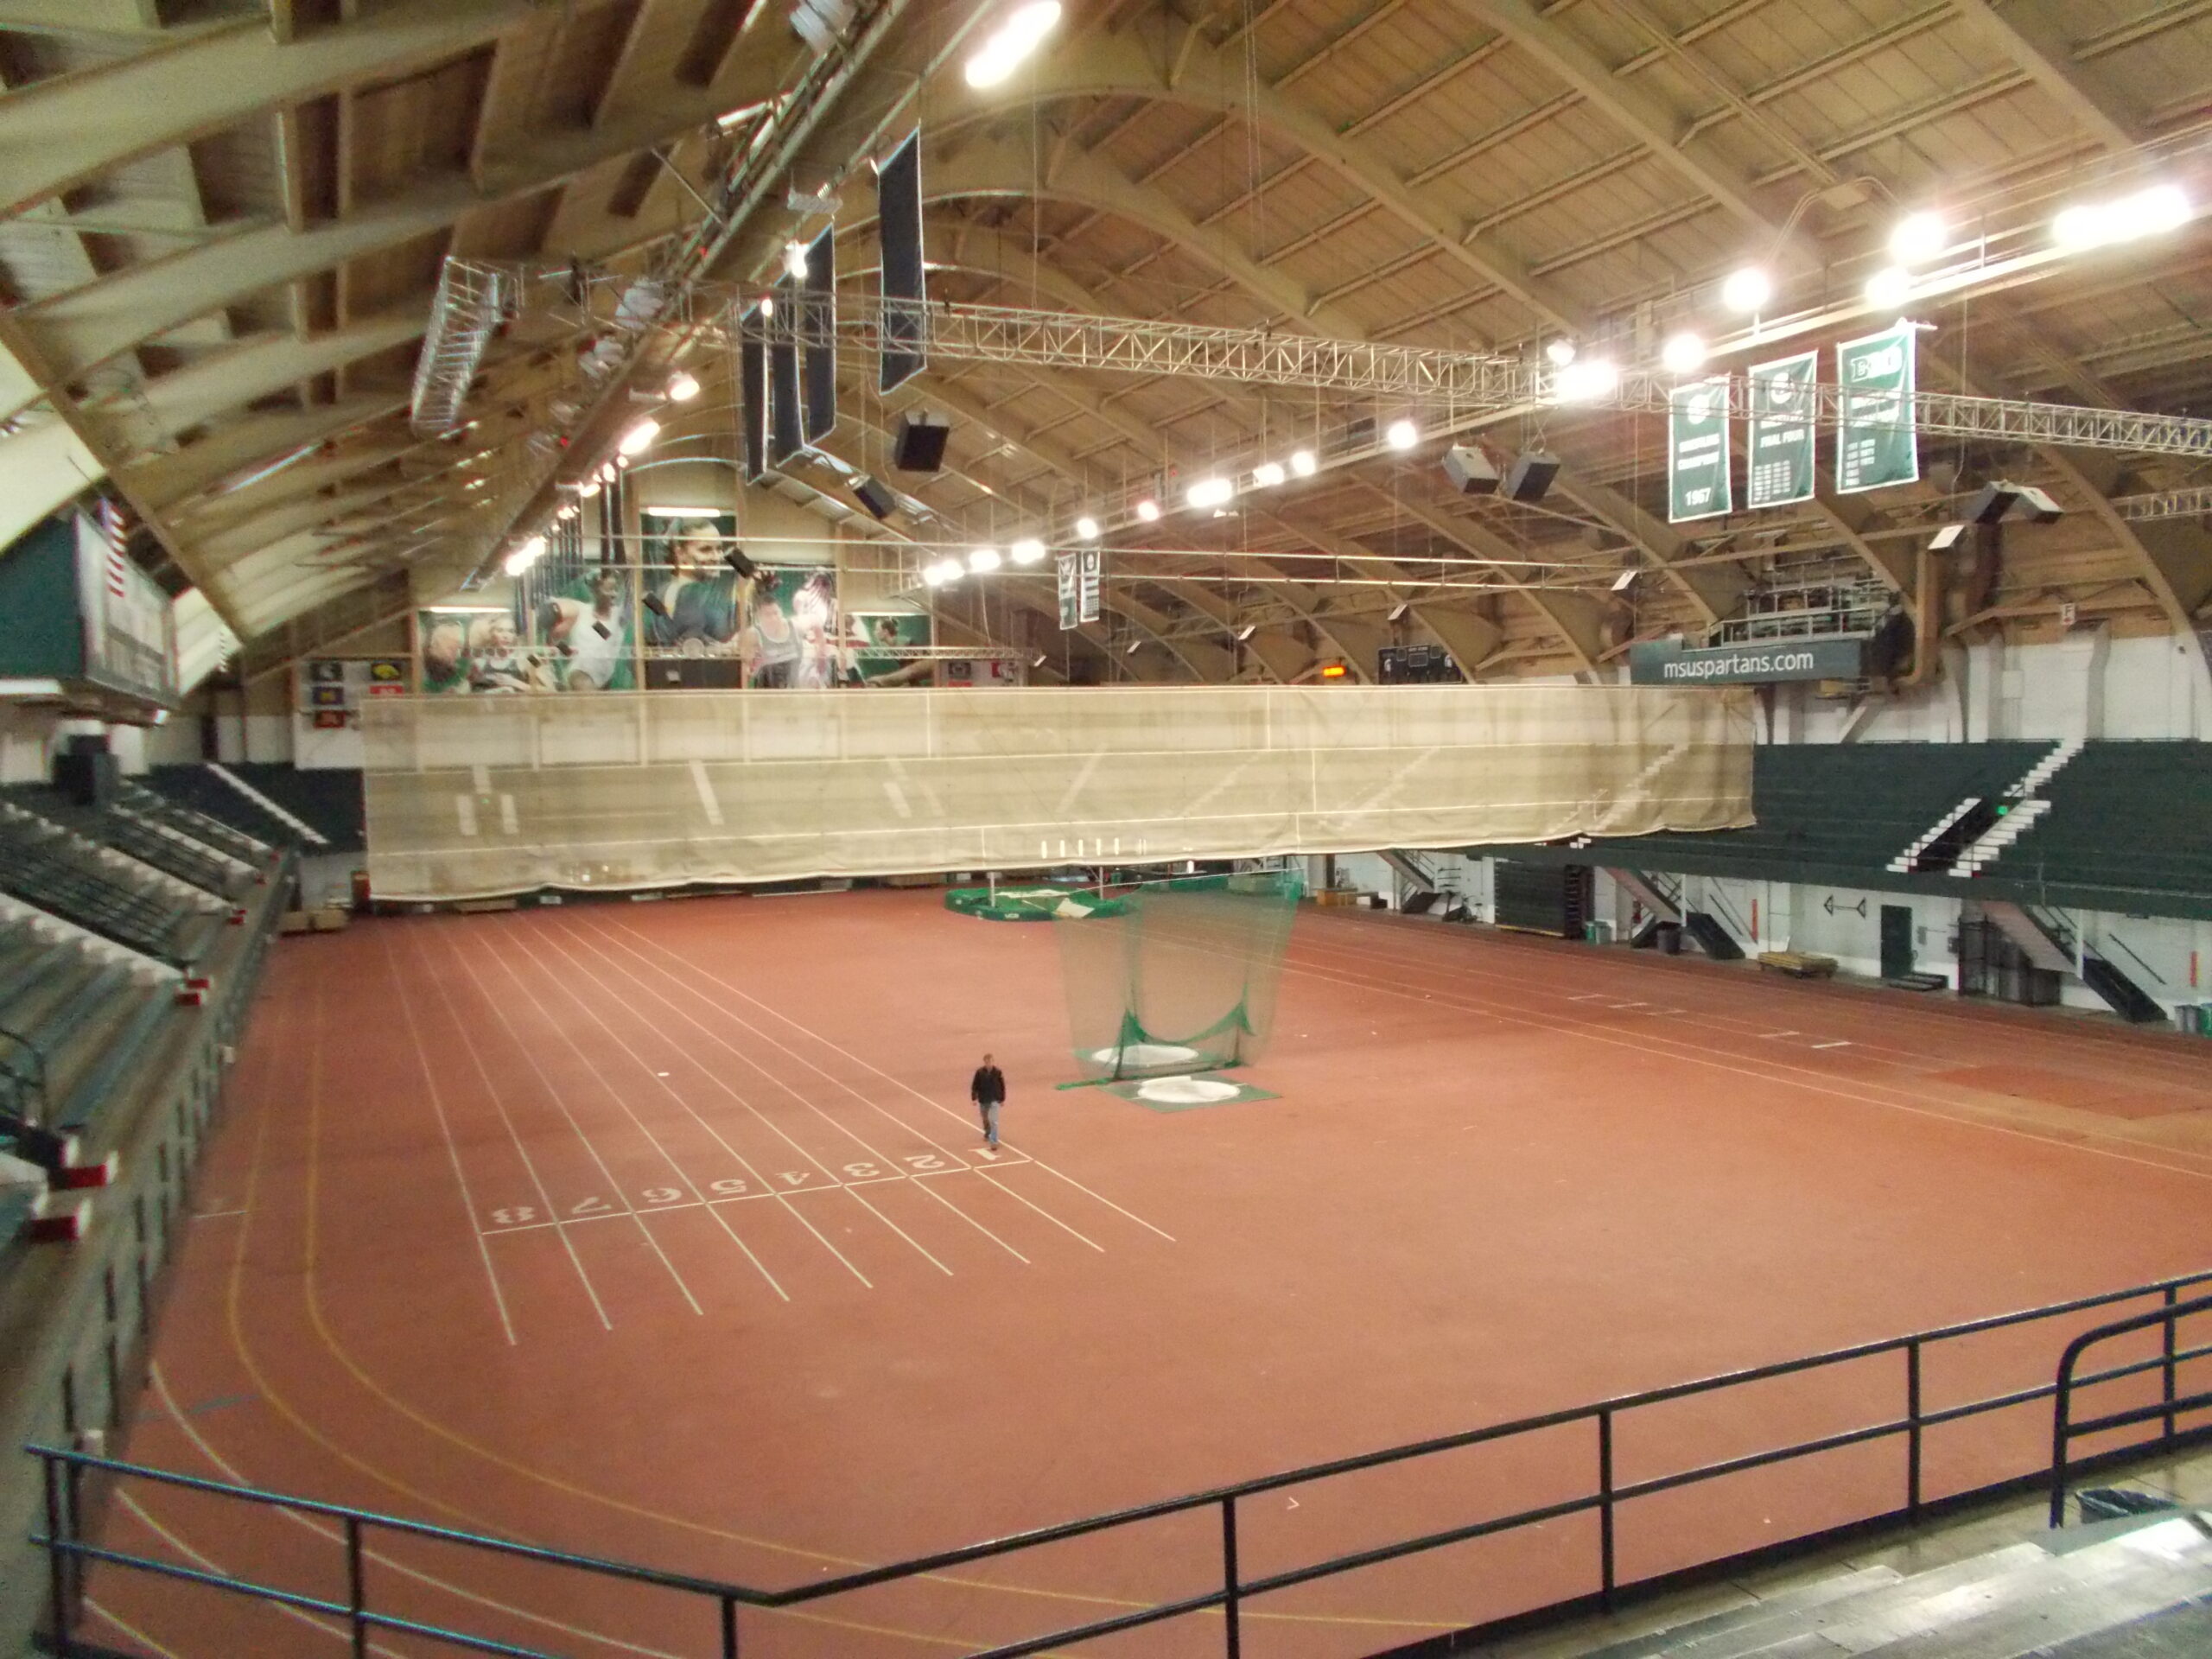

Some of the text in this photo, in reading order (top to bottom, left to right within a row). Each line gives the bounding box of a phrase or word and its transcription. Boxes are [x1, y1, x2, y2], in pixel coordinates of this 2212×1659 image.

[1685, 487, 1711, 506] 1967
[1664, 652, 1814, 679] msuspartans.com
[493, 1147, 1001, 1224] 1 2 3 4 5 6 7 8
